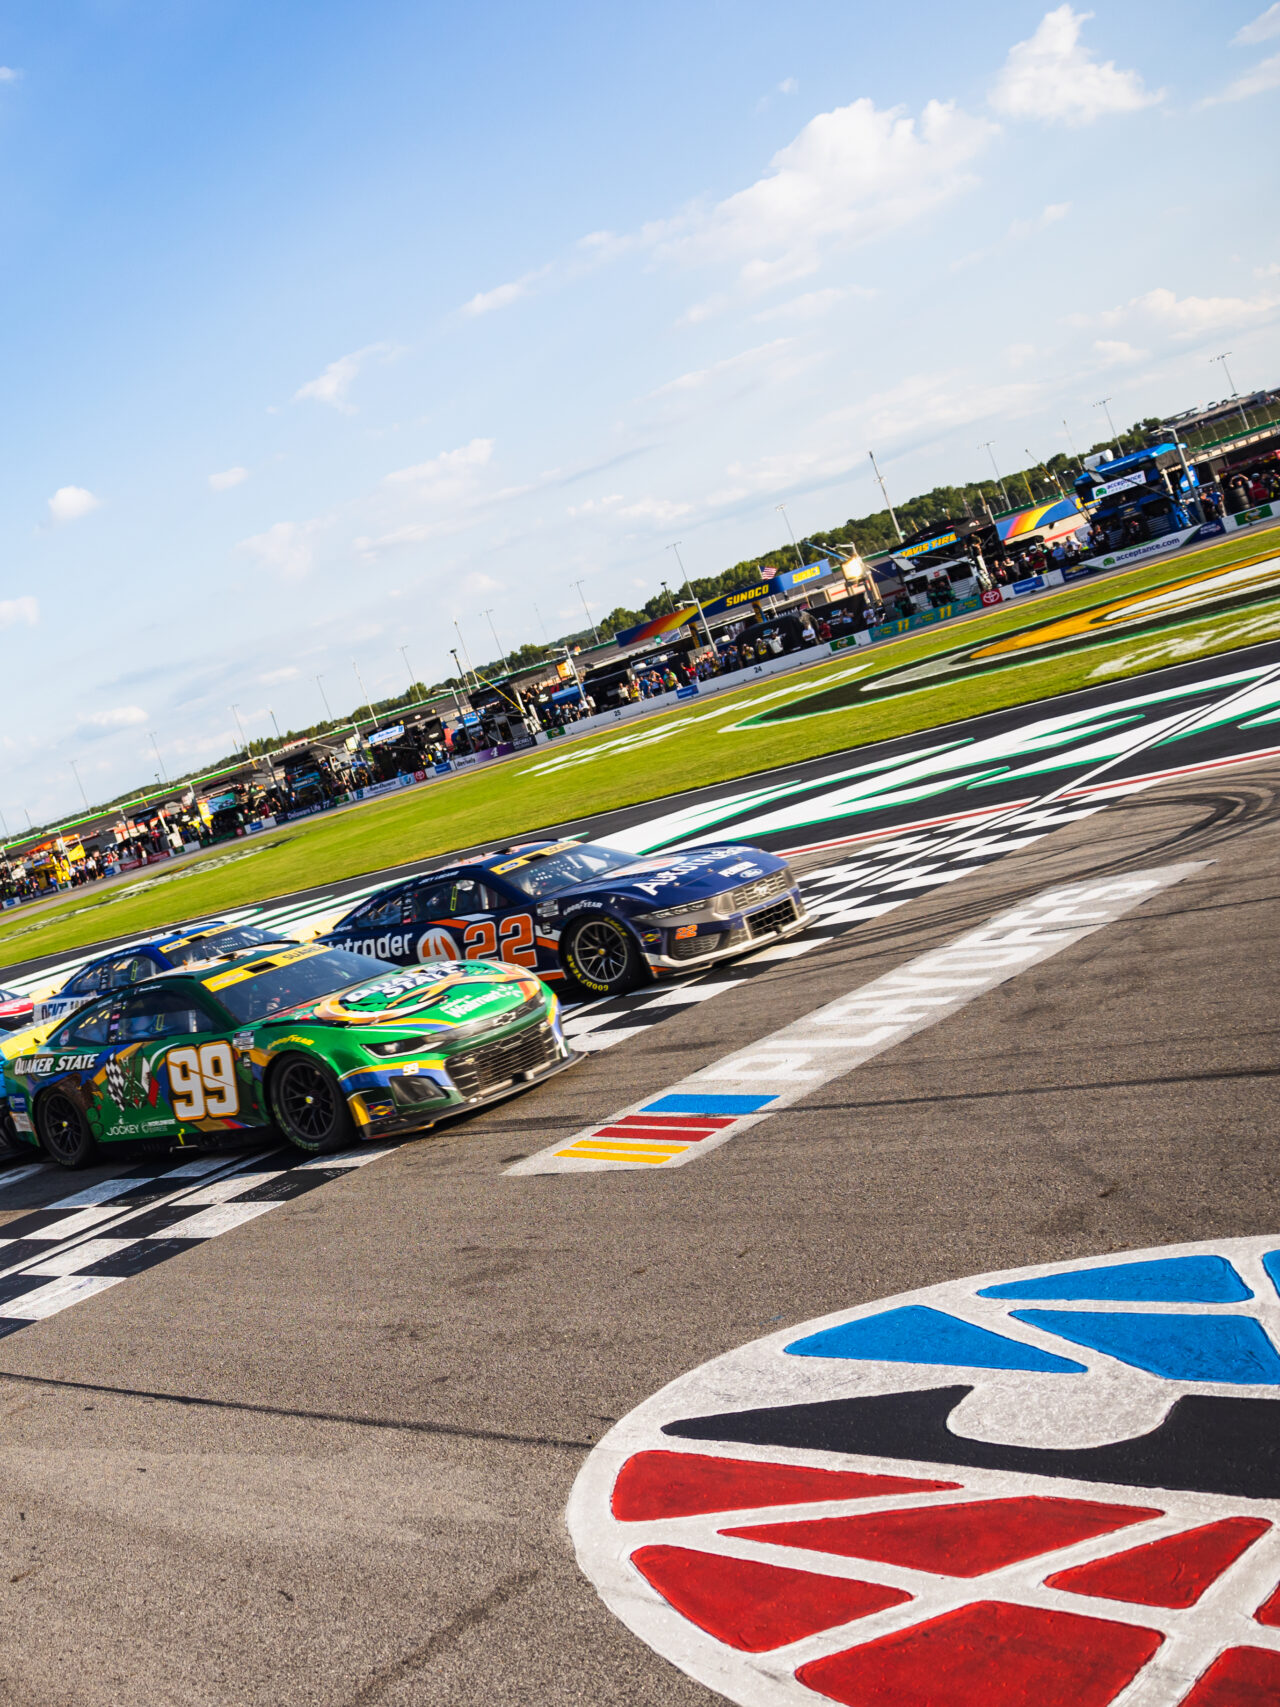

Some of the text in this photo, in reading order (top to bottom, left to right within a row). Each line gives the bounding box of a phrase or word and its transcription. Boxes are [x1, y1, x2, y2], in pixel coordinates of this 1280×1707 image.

[931, 533, 957, 549] TIRE
[1116, 537, 1180, 562] acceptance.com
[792, 566, 821, 584] SUNOCO
[726, 584, 769, 607] SUNOCO
[939, 606, 952, 619] 11
[897, 619, 909, 632] 11
[754, 665, 762, 674] 24
[490, 748, 499, 759] 4
[464, 914, 537, 967] 22
[674, 924, 698, 940] 22
[699, 877, 1162, 1081] PLAYOFFS
[444, 989, 505, 1018] Walmart
[14, 1057, 56, 1076] QUAKER
[55, 1053, 100, 1072] STATE
[403, 1062, 419, 1076] 99
[166, 1040, 240, 1122] 99
[107, 1124, 139, 1136] JOCKEY
